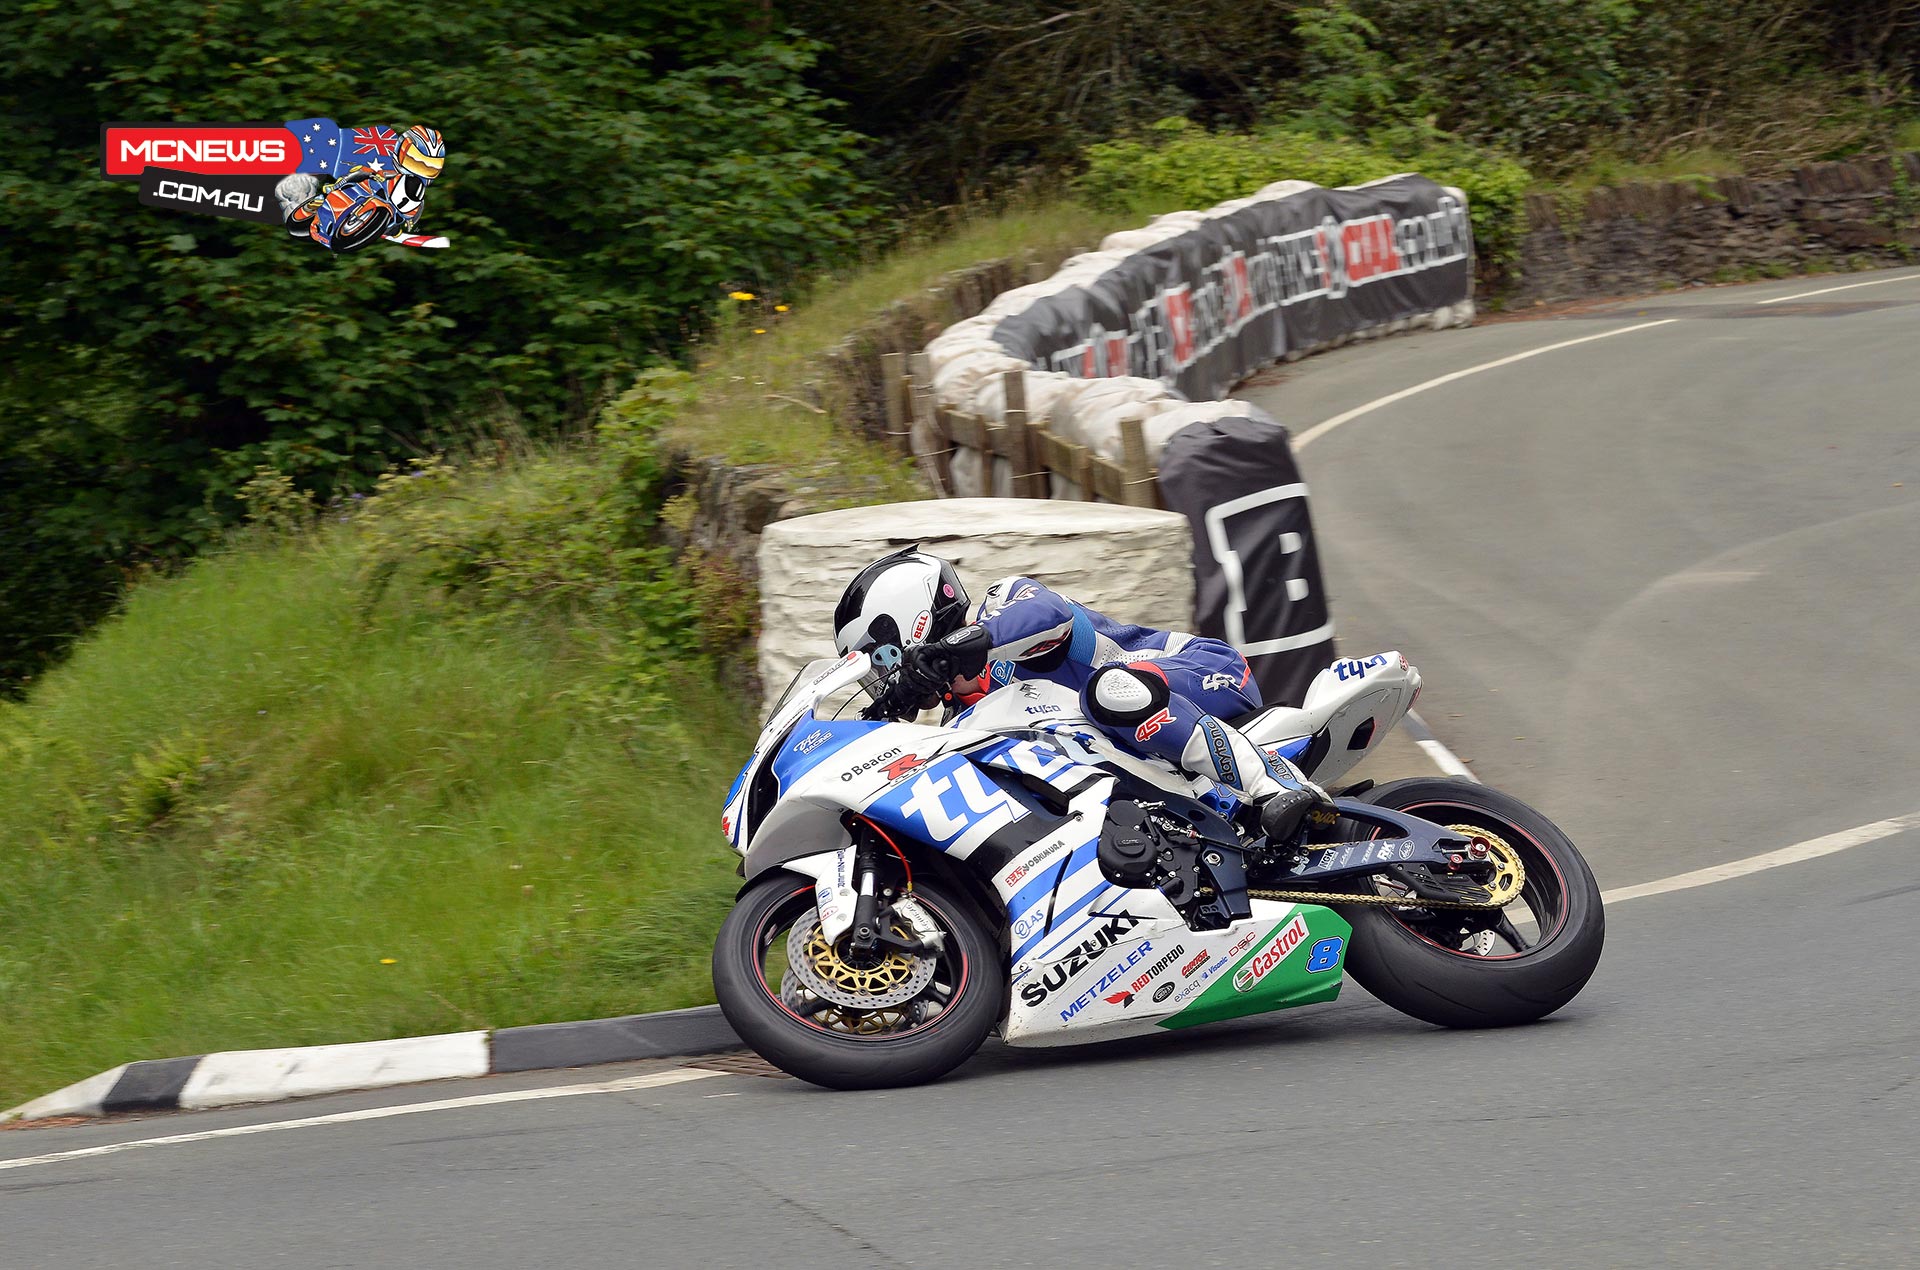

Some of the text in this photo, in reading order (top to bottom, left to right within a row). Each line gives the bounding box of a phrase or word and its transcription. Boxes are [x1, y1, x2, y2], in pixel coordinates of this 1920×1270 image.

[914, 615, 928, 639] BELL
[1025, 704, 1061, 714] tyco
[851, 746, 902, 776] Beacon
[1205, 721, 1236, 784] daytona
[1022, 840, 1065, 872] YOSHIMURA
[1320, 850, 1335, 869] NGK
[1021, 909, 1140, 1007] SUZUKI
[1228, 931, 1256, 957] DSC
[1252, 920, 1306, 978] Castrol
[1305, 936, 1344, 974] 8
[1060, 940, 1153, 1022] METZELER
[1174, 979, 1200, 1003] exacq
